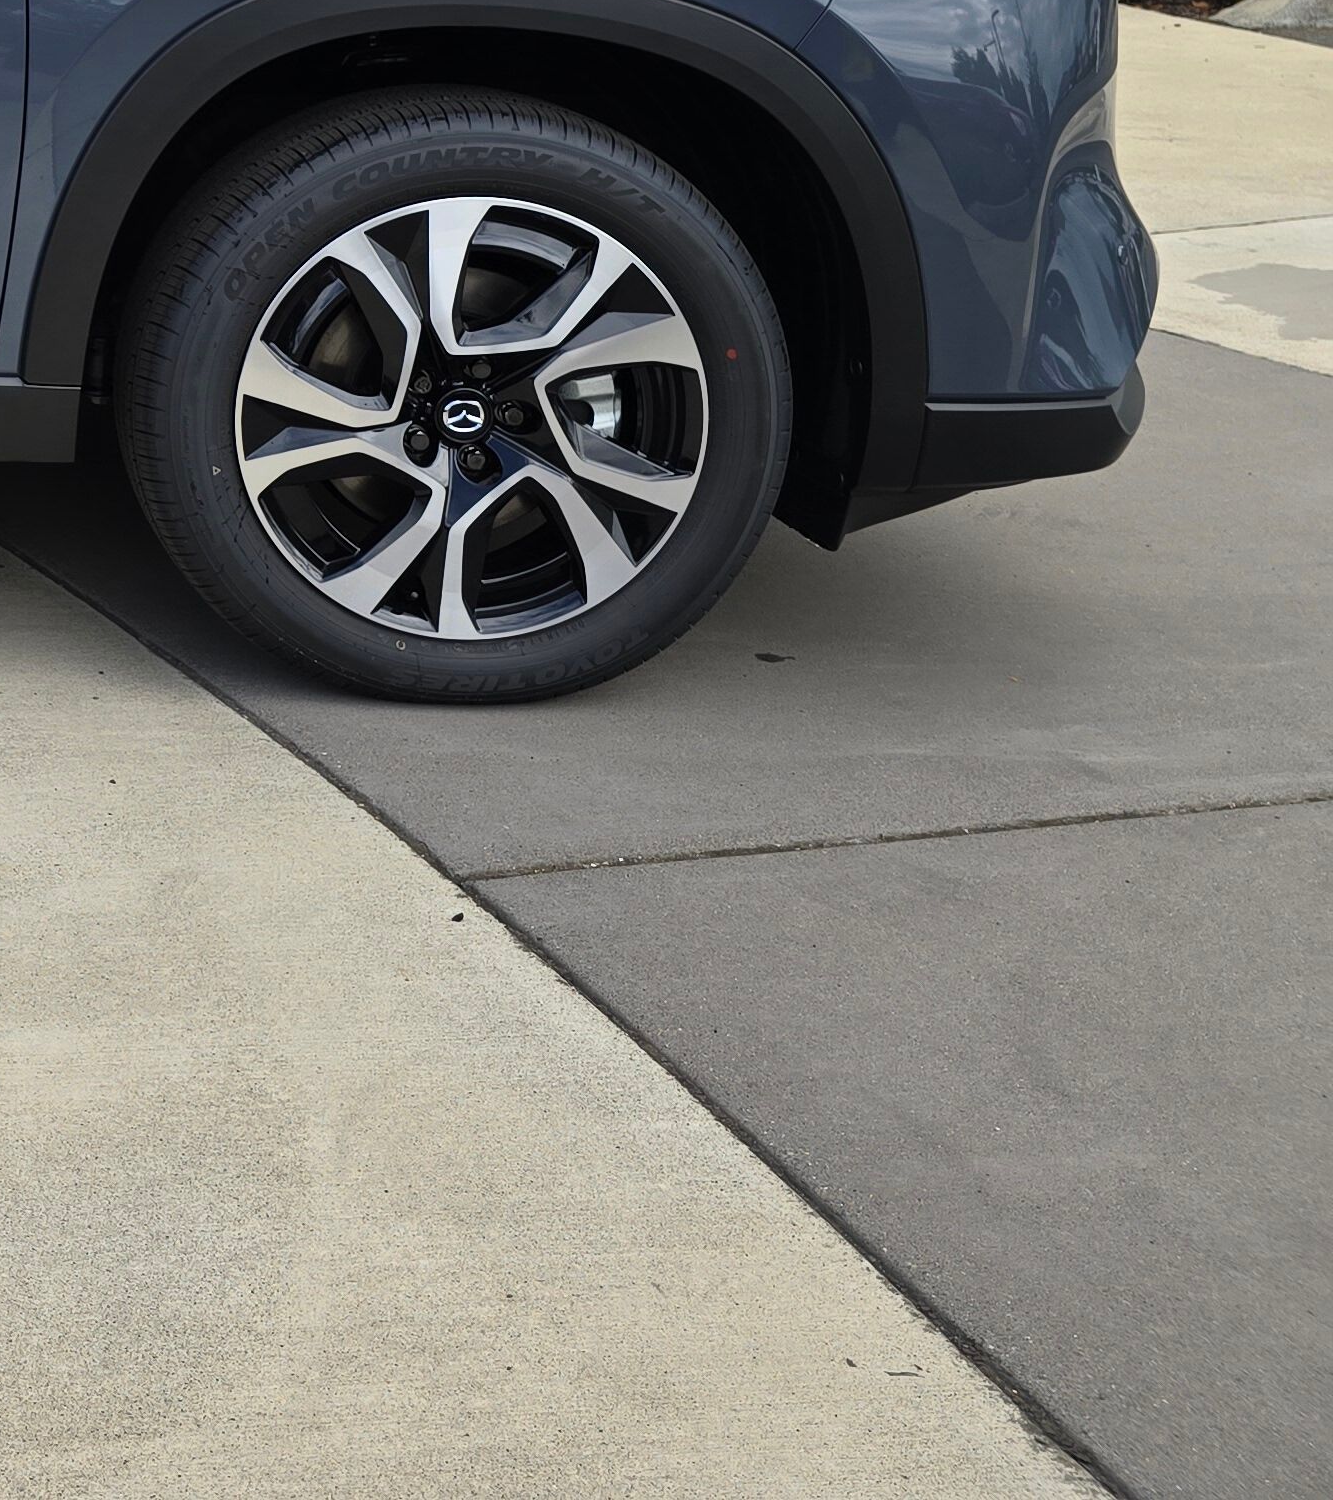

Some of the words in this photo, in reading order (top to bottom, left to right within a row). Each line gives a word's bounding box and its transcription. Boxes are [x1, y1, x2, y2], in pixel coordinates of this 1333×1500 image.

[222, 196, 317, 303] OPEN
[332, 145, 553, 200] COUNTRY
[577, 167, 668, 218] H/T
